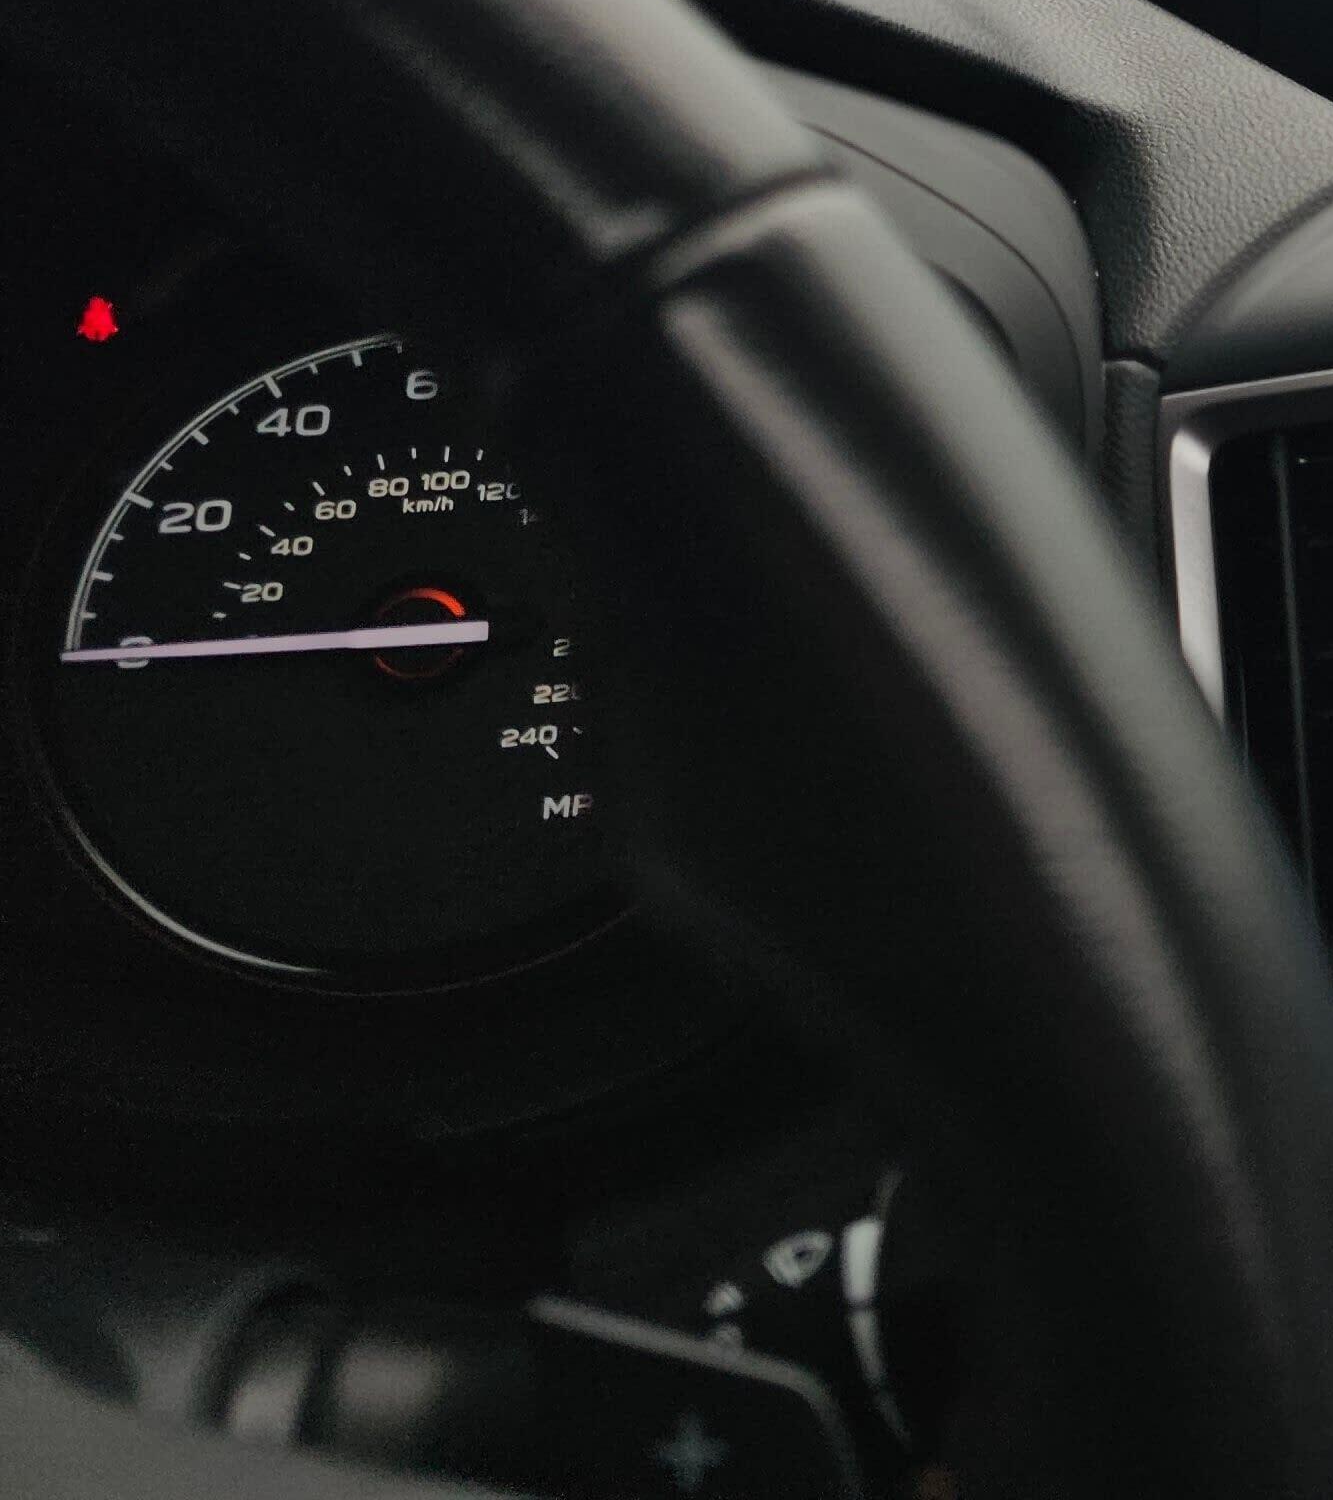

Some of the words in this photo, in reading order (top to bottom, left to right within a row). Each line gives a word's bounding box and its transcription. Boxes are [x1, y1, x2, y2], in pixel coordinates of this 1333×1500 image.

[405, 369, 438, 400] 6
[256, 404, 331, 438] 40
[367, 477, 410, 498] 80
[420, 470, 471, 491] 100
[314, 499, 357, 521] 60
[400, 494, 454, 514] km/h
[158, 499, 233, 534] 20
[268, 533, 314, 557] 40
[239, 580, 286, 604] 20
[532, 683, 578, 705] 22
[500, 724, 559, 749] 240
[543, 793, 592, 820] MP
